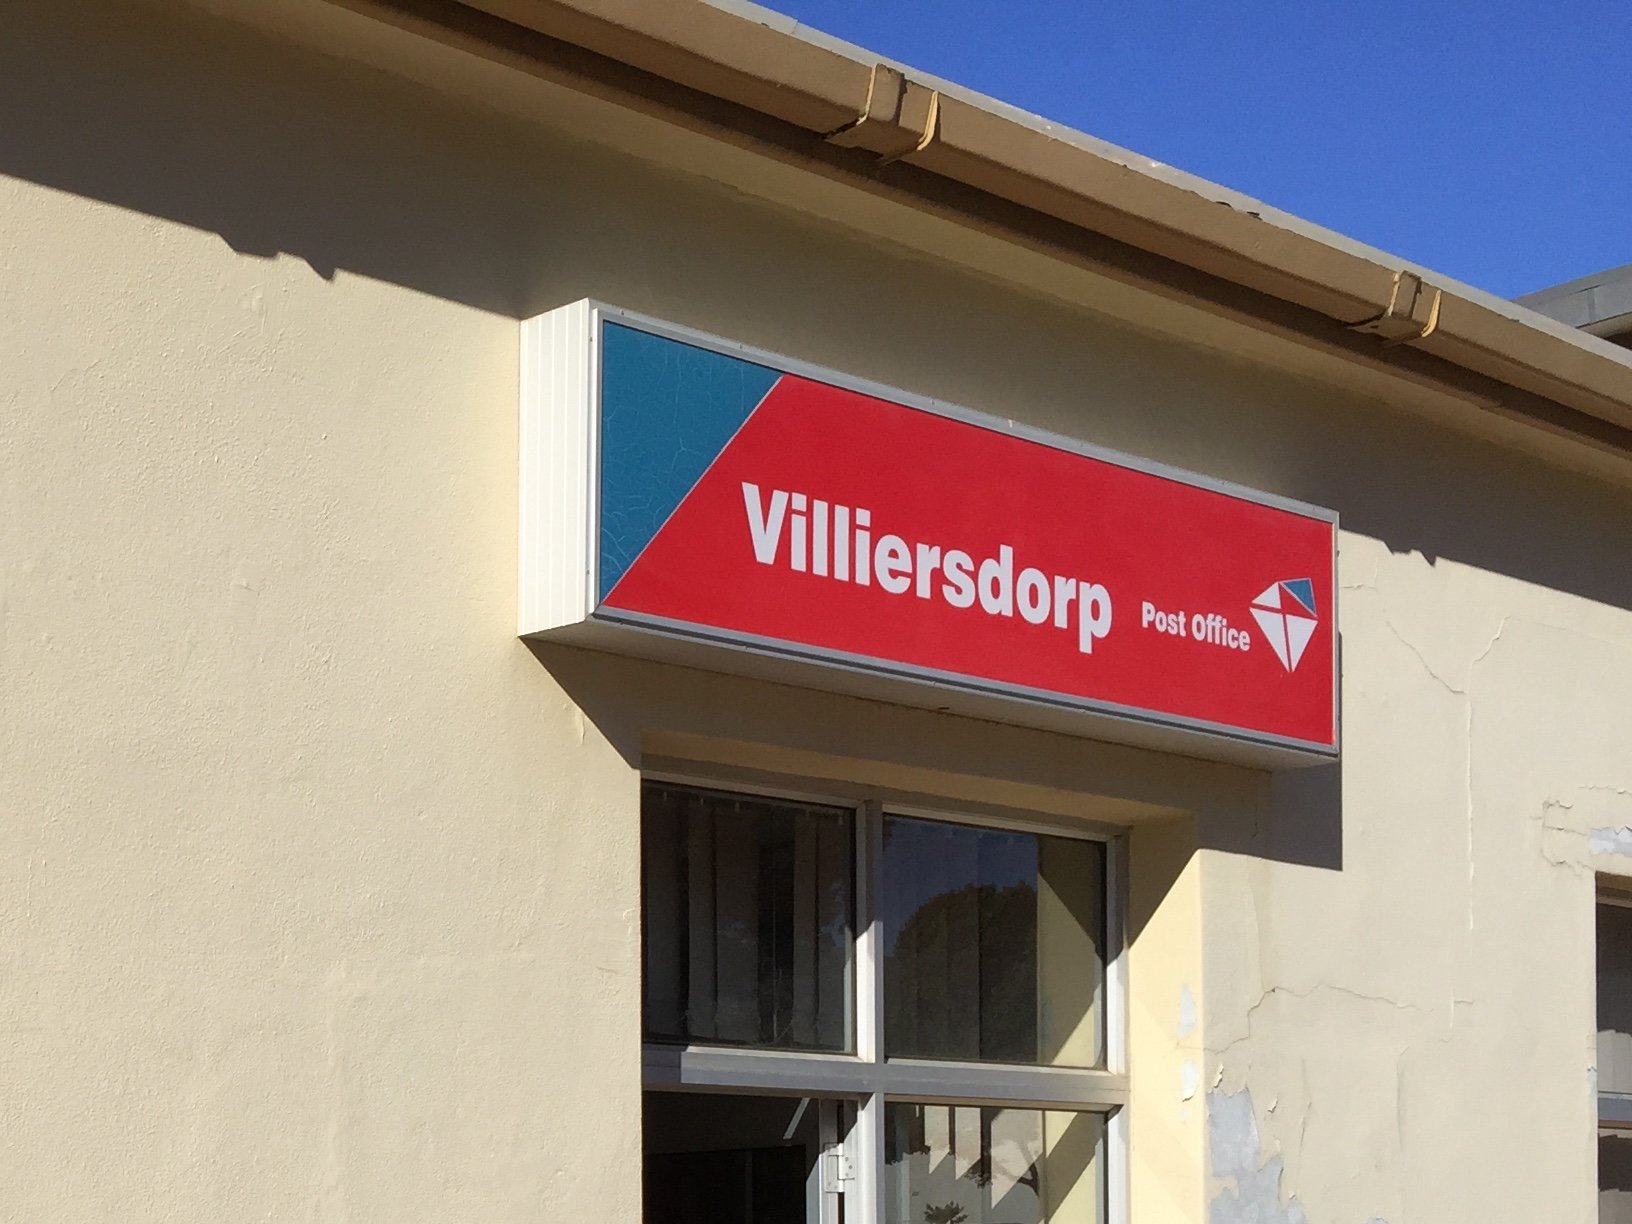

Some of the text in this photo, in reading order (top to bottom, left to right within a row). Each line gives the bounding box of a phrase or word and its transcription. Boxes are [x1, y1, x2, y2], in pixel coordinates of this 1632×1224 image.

[741, 481, 1113, 654] Villiersdorp
[1141, 600, 1251, 652] Post Office
